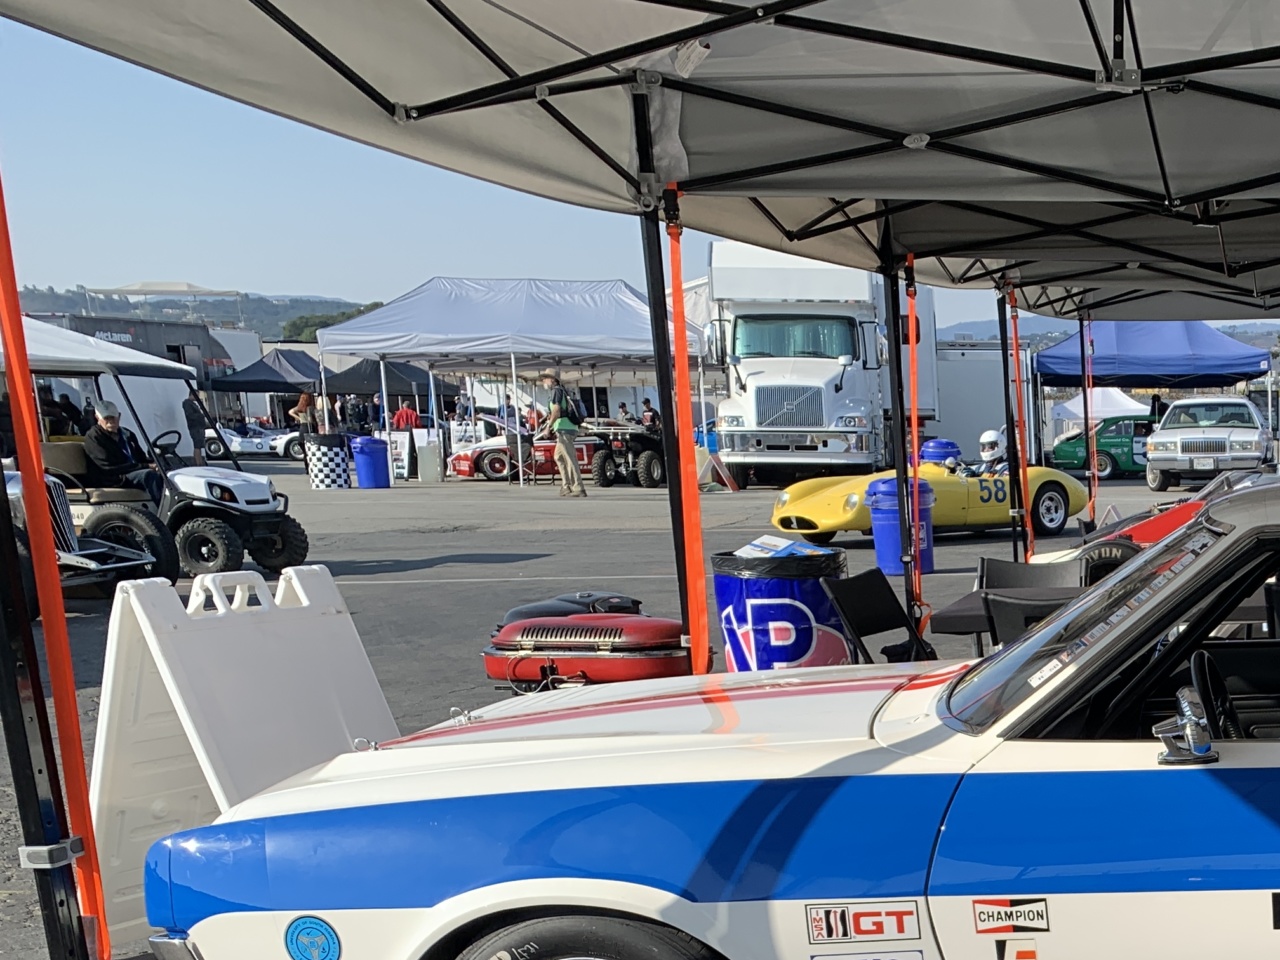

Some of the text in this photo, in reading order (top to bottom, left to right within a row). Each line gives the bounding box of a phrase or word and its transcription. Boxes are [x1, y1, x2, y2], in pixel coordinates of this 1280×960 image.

[95, 330, 132, 342] McLaren
[978, 478, 1008, 504] 58
[813, 910, 914, 939] IMSA GT
[978, 909, 1045, 924] CHAMPION
